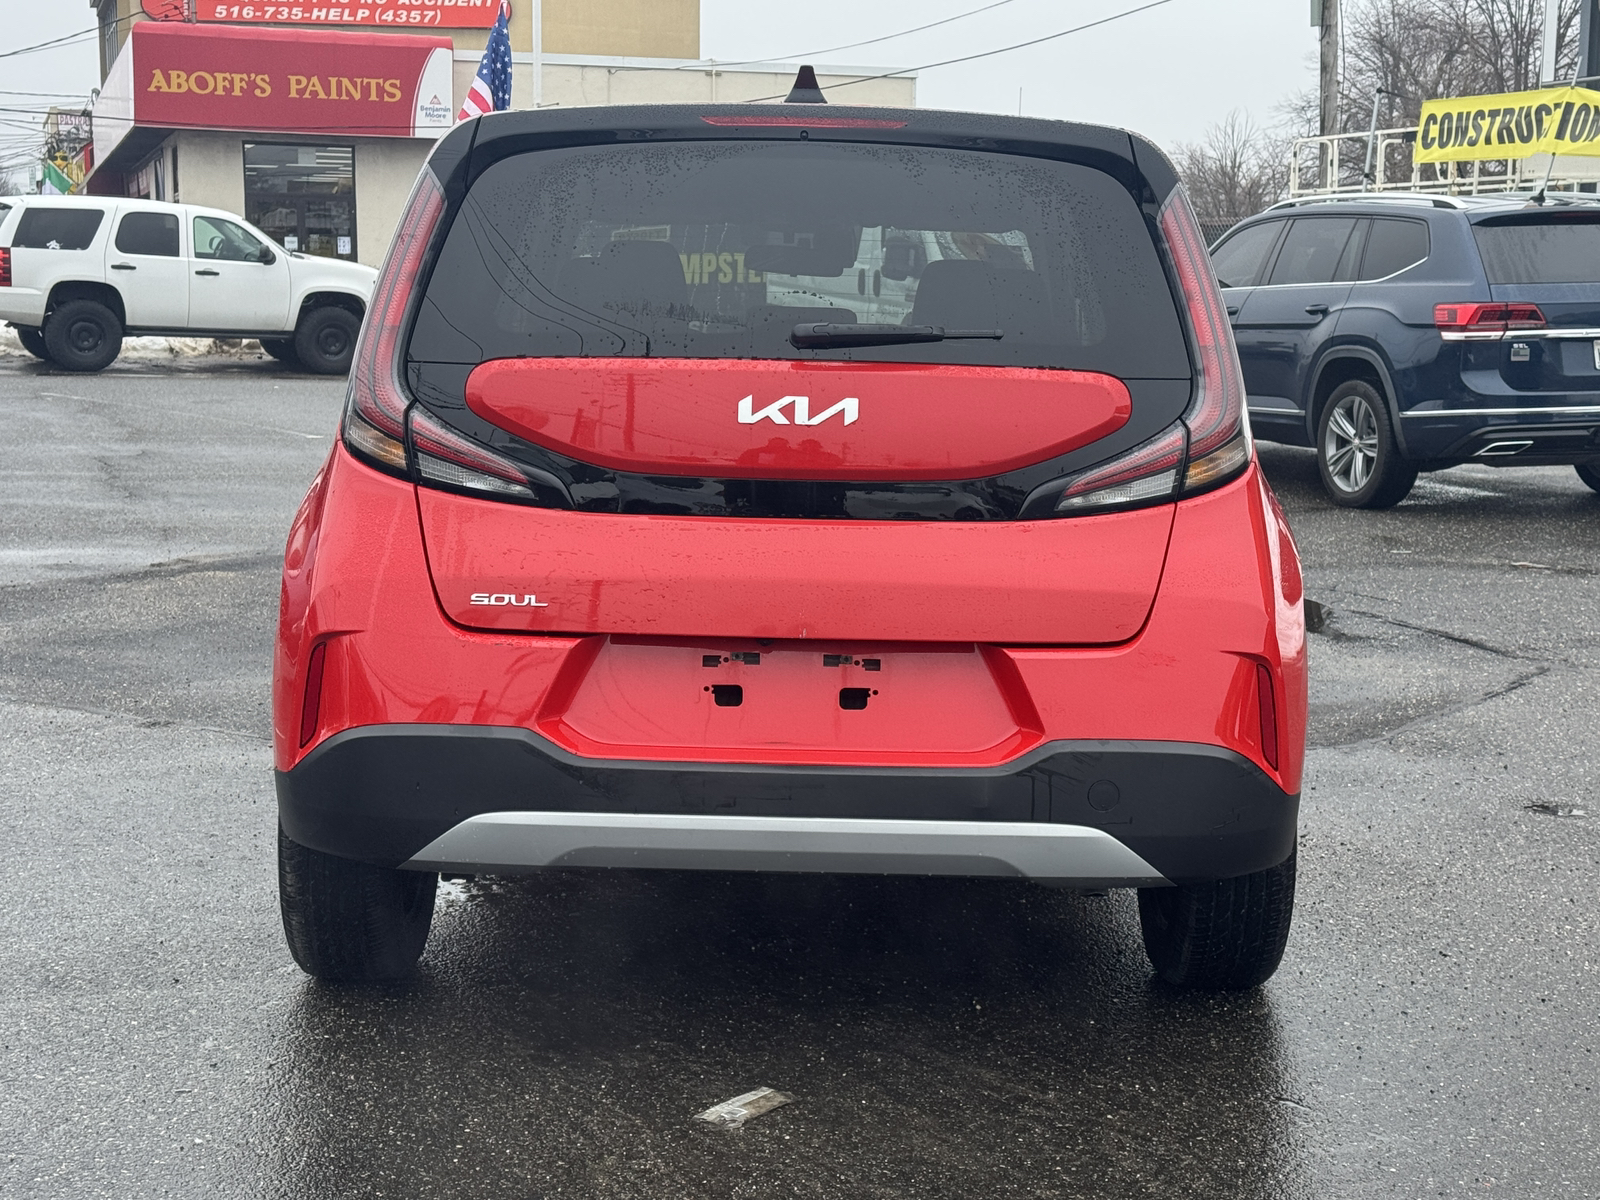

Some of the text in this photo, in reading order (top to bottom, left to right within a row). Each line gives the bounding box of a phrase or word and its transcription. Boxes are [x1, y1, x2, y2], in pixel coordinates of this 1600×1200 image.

[214, 5, 441, 24] 516-735-HELP (4357)
[147, 69, 402, 102] ABOFF'S PAINTS
[420, 105, 451, 113] Benjamin
[425, 111, 447, 119] Moore
[738, 394, 859, 426] KIA
[470, 593, 549, 607] SOUL
